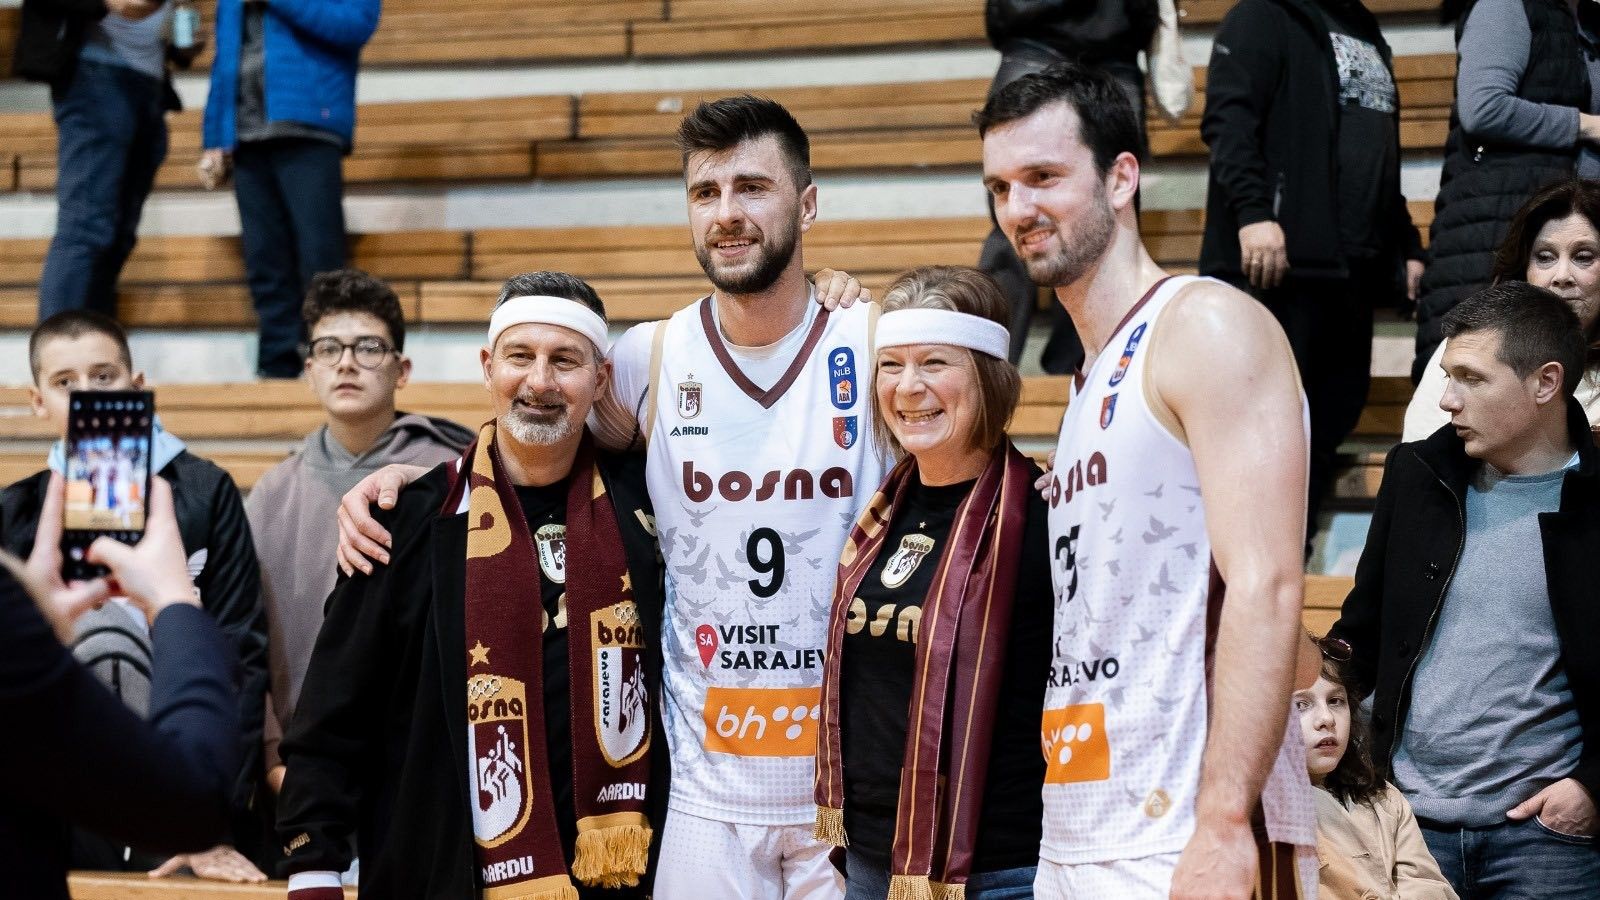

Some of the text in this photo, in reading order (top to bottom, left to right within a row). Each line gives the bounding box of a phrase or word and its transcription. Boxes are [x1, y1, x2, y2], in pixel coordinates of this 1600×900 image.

[833, 367, 852, 378] NLB
[838, 392, 851, 402] ABA
[682, 426, 709, 436] ARDU
[683, 461, 853, 503] bosna
[1051, 451, 1108, 510] osna
[902, 538, 931, 552] bosna
[746, 527, 786, 598] 9
[846, 597, 924, 644] osn
[597, 620, 645, 646] bosn
[699, 633, 714, 647] SA
[719, 625, 780, 645] VISIT
[720, 649, 825, 670] SARAJE
[469, 697, 524, 722] osna
[715, 704, 767, 740] bh
[607, 782, 647, 801] ARDU
[487, 855, 534, 883] ARDU
